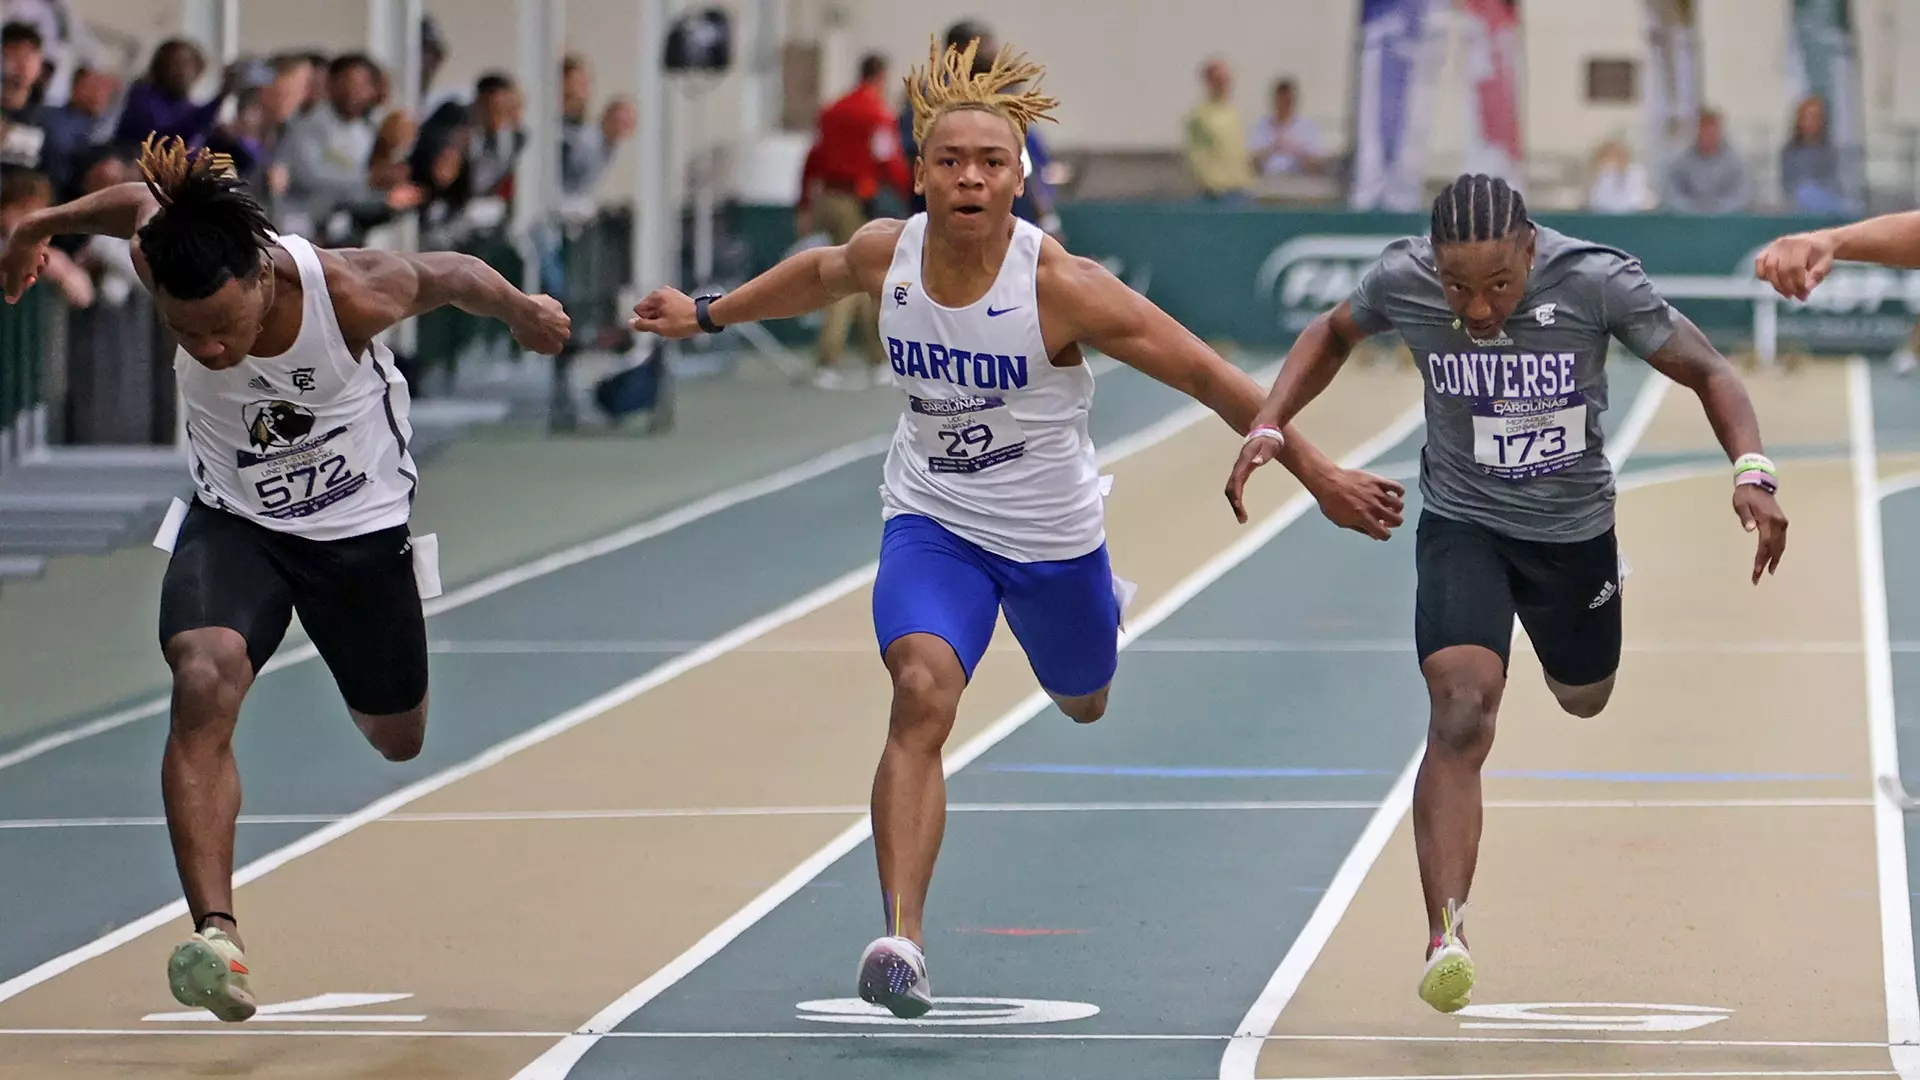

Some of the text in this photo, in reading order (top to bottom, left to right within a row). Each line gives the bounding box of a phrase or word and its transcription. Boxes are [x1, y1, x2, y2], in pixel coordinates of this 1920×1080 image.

[887, 336, 1028, 390] BARTON
[1428, 353, 1576, 398] CONVERSE
[922, 396, 987, 412] CAROLINAS
[1494, 397, 1569, 415] CAROLINAS
[938, 424, 994, 458] 29
[1493, 426, 1566, 464] 173
[254, 454, 352, 509] 572
[260, 466, 282, 477] UNC
